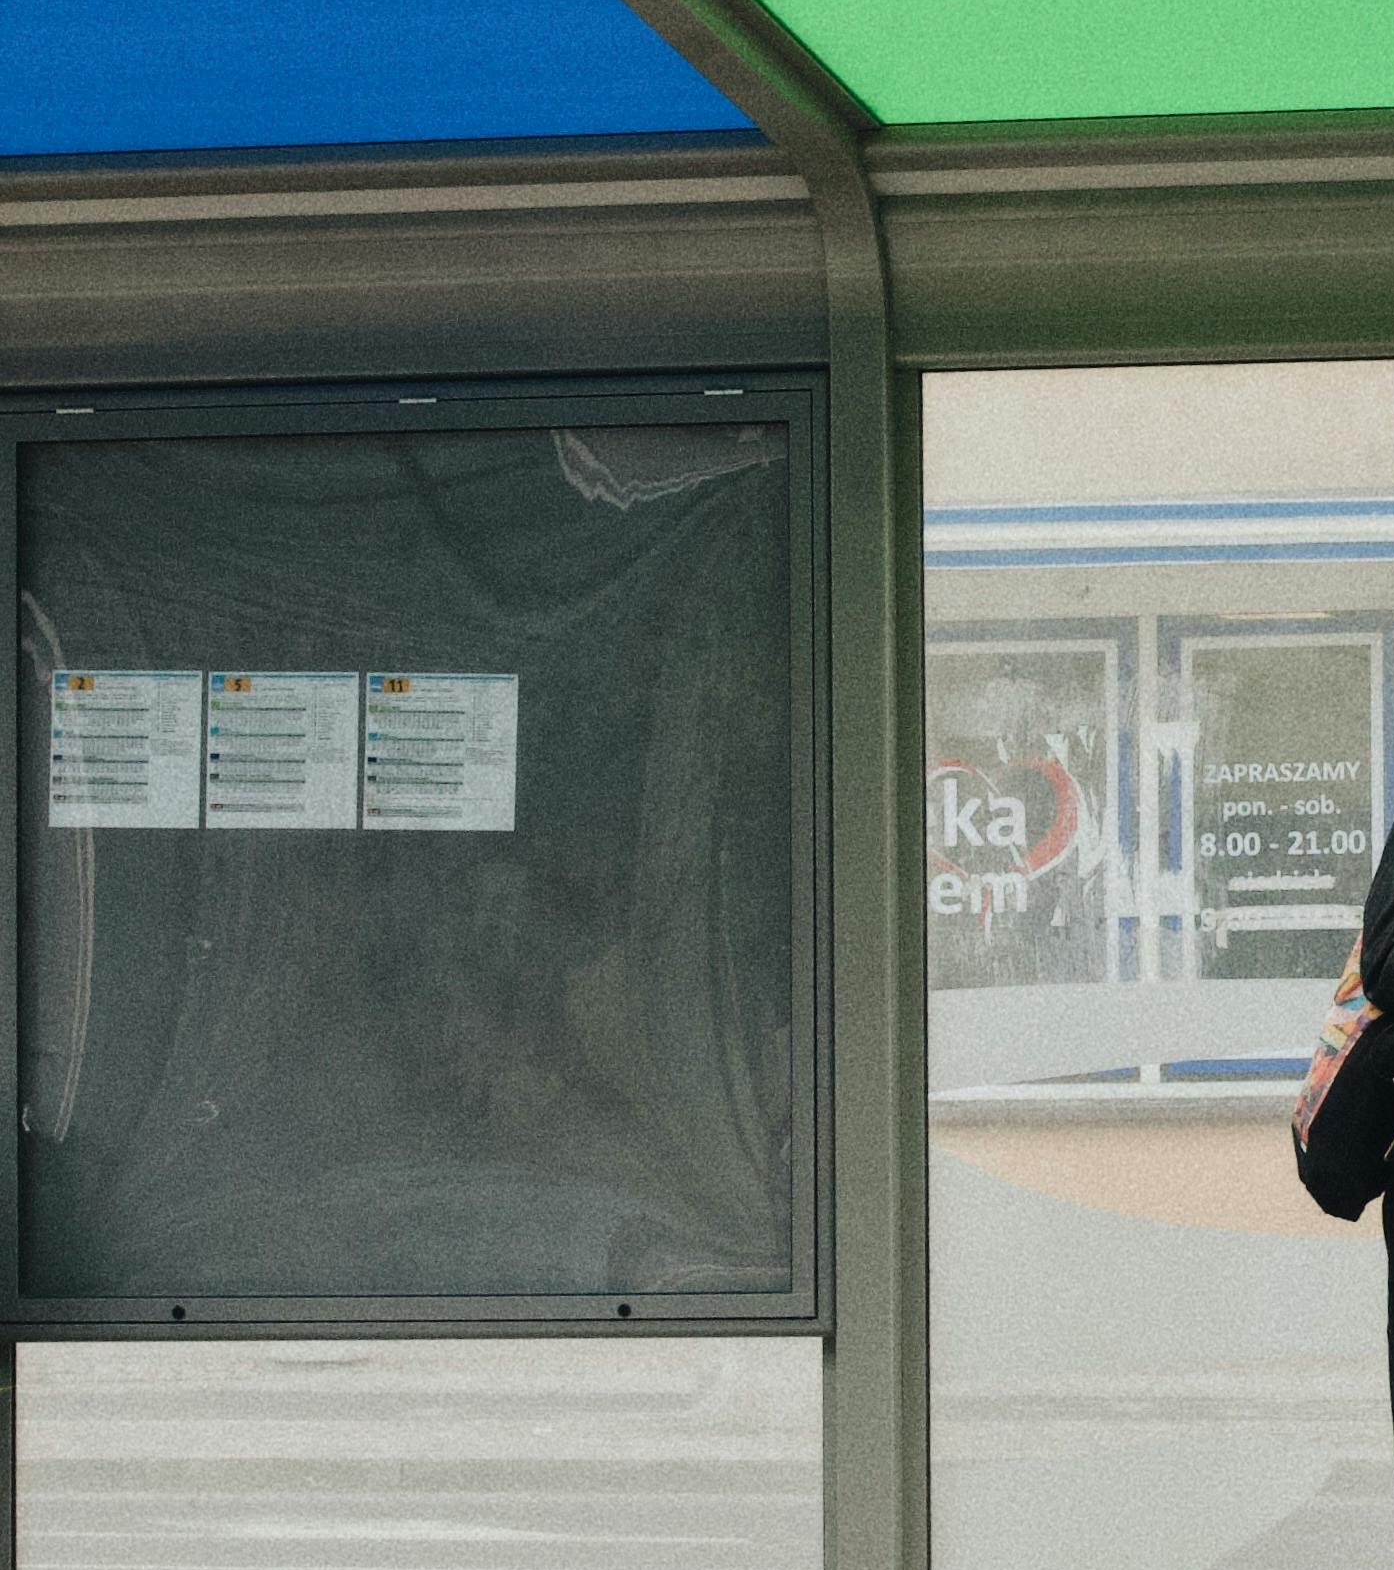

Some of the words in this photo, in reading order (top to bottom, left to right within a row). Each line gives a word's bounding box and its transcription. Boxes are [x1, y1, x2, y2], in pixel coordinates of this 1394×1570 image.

[76, 676, 85, 690] 2
[234, 678, 242, 691] 5
[389, 679, 403, 692] 11
[1203, 761, 1360, 783] ZAPRASZAMY
[1223, 800, 1273, 822] pon.
[1294, 794, 1341, 815] sob.
[1200, 832, 1261, 857] 8.00
[1287, 829, 1366, 855] 21.00
